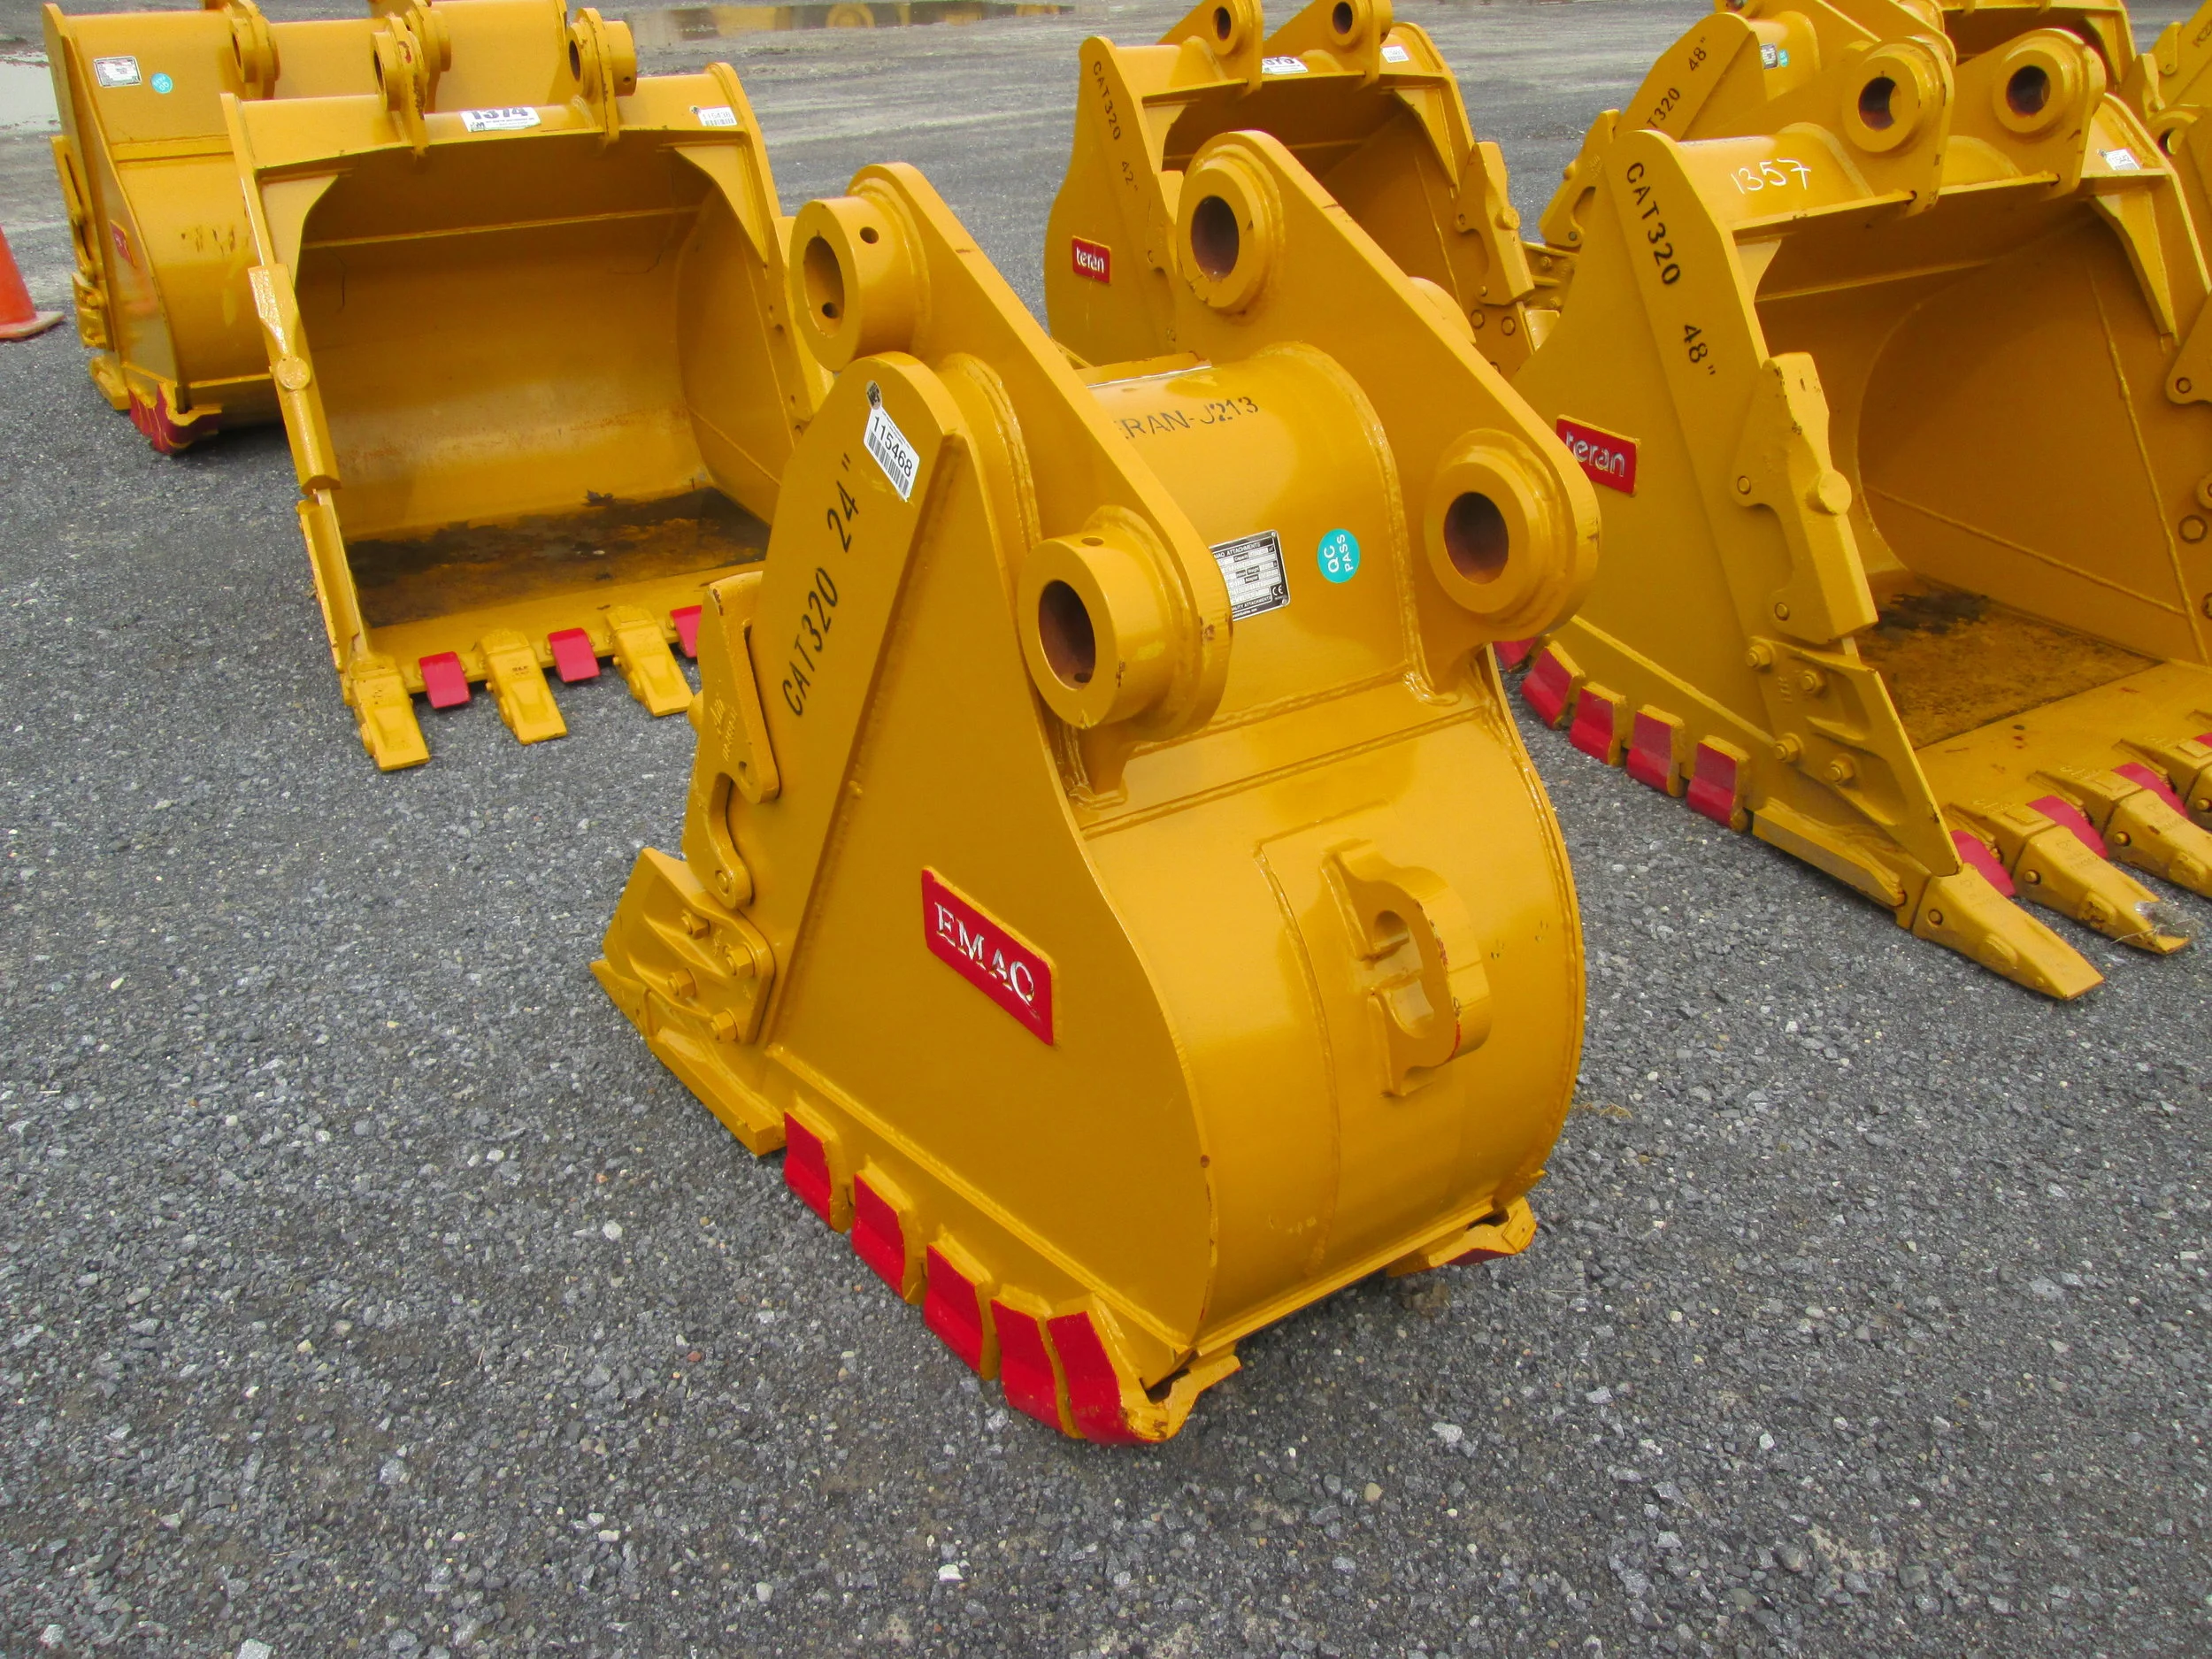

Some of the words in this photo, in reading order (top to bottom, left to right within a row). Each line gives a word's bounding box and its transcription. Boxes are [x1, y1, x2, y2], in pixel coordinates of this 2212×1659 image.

[1093, 60, 1121, 141] CAT320
[1647, 87, 1681, 129] T320
[1688, 36, 1707, 72] 48"
[1730, 157, 1812, 195] 1357
[1076, 246, 1105, 273] teran
[1626, 162, 1681, 286] CAT320
[1683, 324, 1717, 375] 48"
[1116, 396, 1259, 441] RAN-J213
[873, 415, 913, 479] 115468
[1565, 430, 1625, 478] teran
[1324, 545, 1340, 573] QC
[1336, 534, 1354, 572] PASS
[782, 566, 838, 718] CAT320
[827, 452, 859, 553] 24"
[934, 901, 1035, 1007] EMAQ
